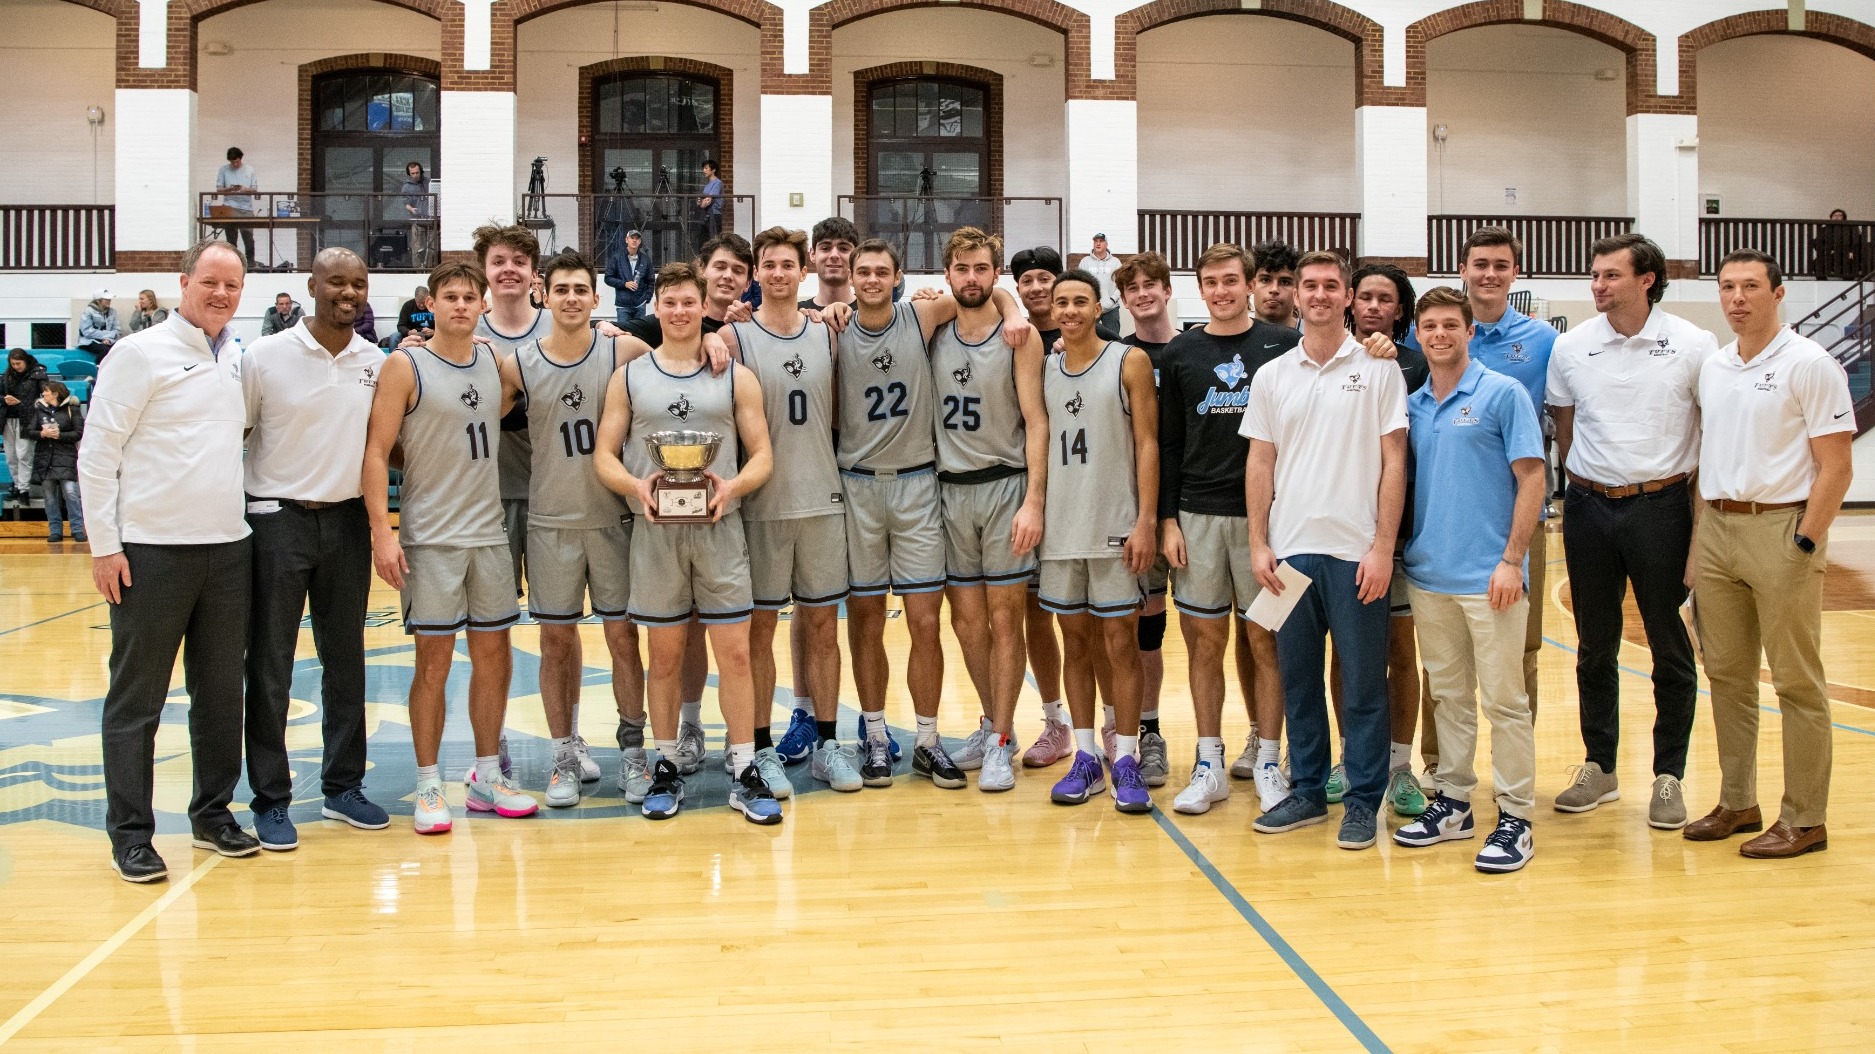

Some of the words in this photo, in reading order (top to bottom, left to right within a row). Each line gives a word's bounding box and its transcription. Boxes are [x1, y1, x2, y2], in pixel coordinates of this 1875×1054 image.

[411, 312, 434, 322] TUFT
[788, 389, 808, 426] 0
[864, 381, 909, 422] 22
[942, 395, 981, 432] 25
[1196, 385, 1251, 415] Jumb
[1210, 406, 1247, 414] BASKETBA
[466, 421, 490, 460] 11
[559, 418, 596, 458] 10
[1060, 428, 1088, 466] 14
